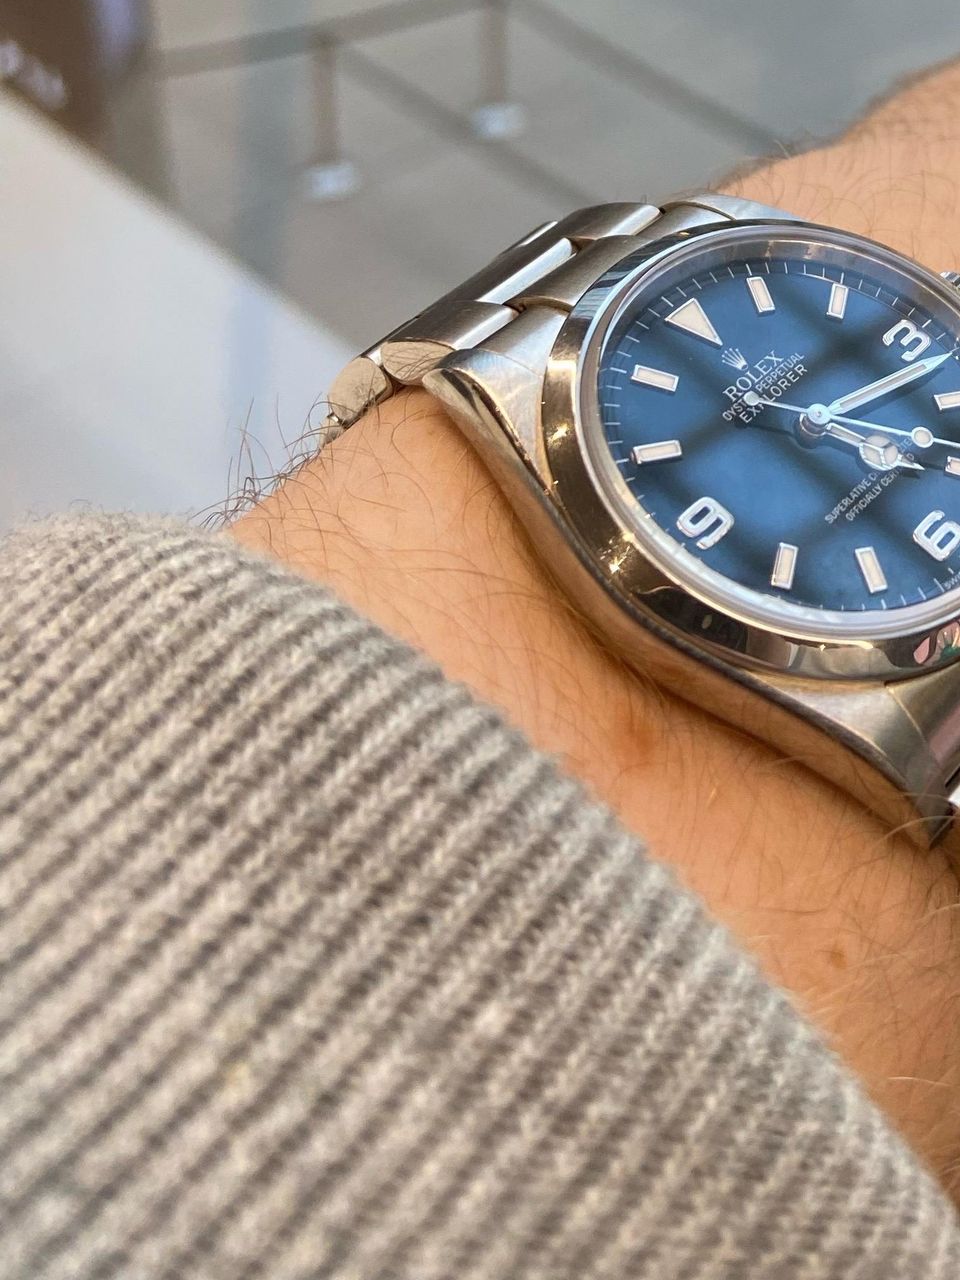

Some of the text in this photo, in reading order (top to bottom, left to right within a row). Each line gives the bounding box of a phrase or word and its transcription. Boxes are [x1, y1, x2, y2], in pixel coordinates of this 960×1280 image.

[882, 319, 932, 362] 3
[722, 350, 785, 402] ROLEX
[755, 352, 805, 393] PERPETUAL
[676, 496, 735, 550] 9
[824, 478, 872, 524] SUPERLATIVE
[845, 483, 883, 521] OFFICIALLY
